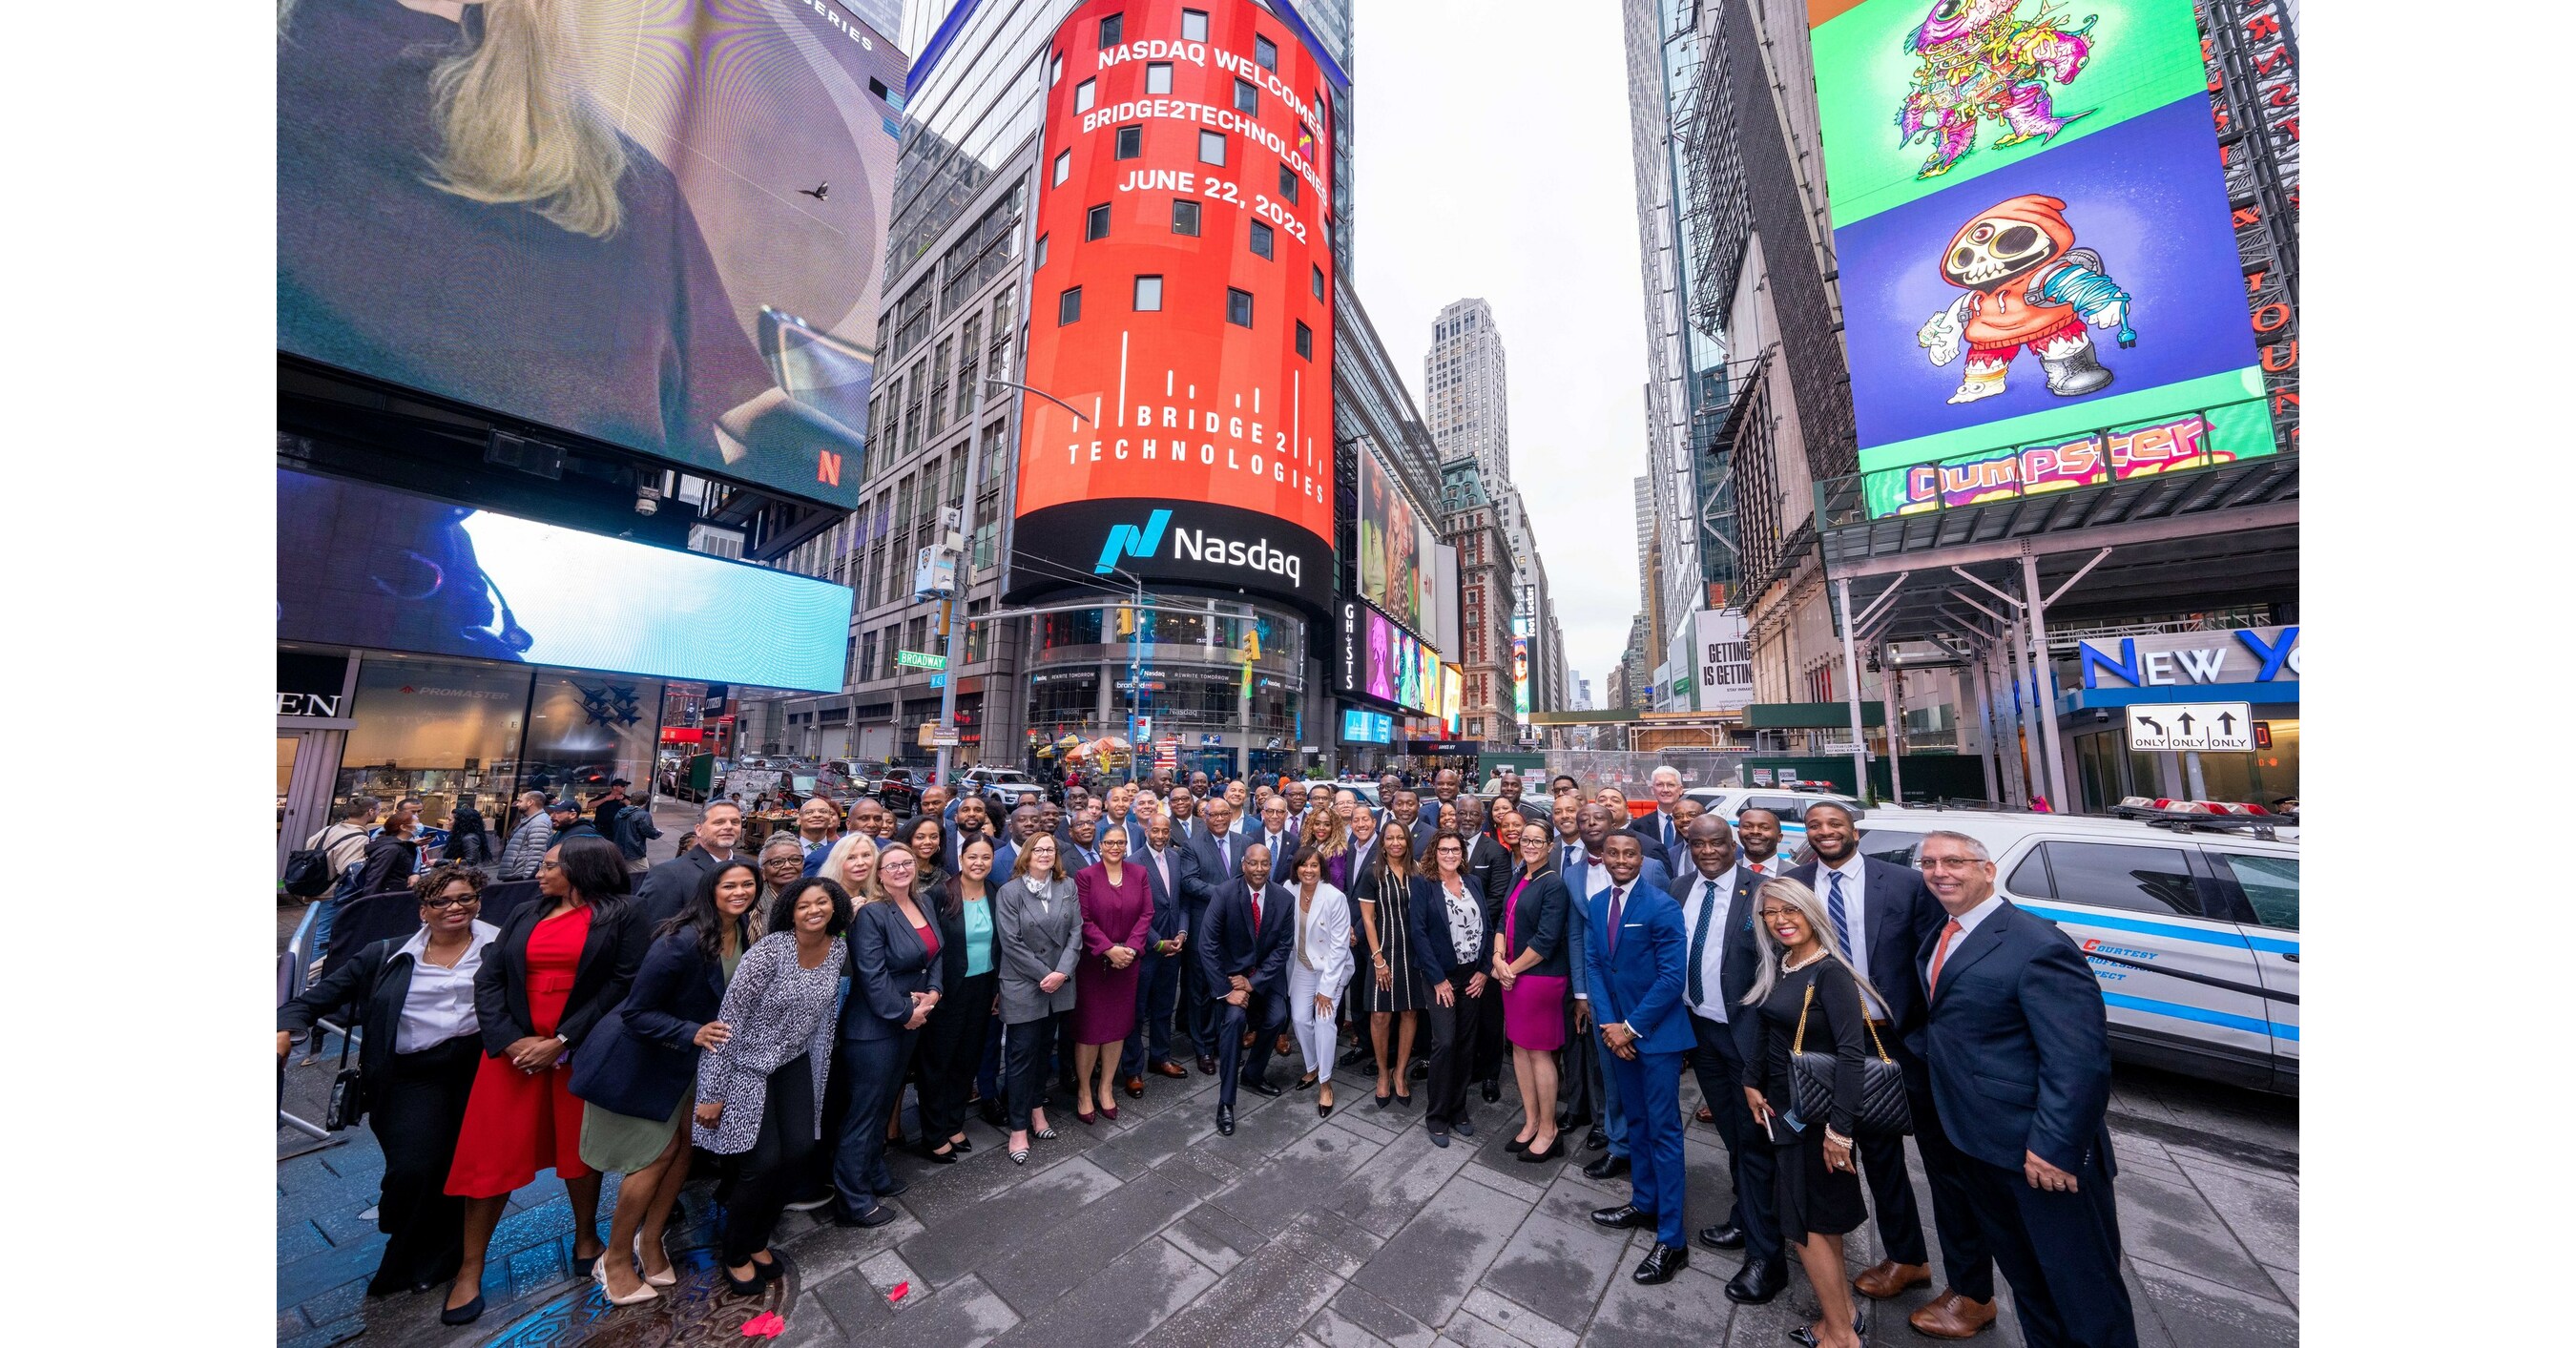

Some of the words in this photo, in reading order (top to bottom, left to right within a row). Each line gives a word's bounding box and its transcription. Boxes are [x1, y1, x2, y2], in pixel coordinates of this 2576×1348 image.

[1098, 40, 1206, 71] NASDAQ
[1215, 48, 1324, 145] WELCOMES
[1083, 99, 1328, 208] BRIDGE2TECHNOLOGIES
[1119, 170, 1195, 193] JUNE
[1204, 176, 1246, 209] 22,
[1256, 195, 1307, 244] 2022
[1137, 405, 1263, 445] BRIDGE
[1277, 432, 1287, 453] 2
[819, 450, 841, 487] N
[1069, 439, 1323, 504] TECHNOLOGIES
[1174, 528, 1299, 588] Nasdaq
[901, 653, 944, 668] BROADWAY
[937, 675, 943, 685] 43
[1144, 670, 1165, 678] Nasdaq
[1703, 666, 1714, 686] IS
[418, 687, 510, 700] PROMASTER
[1169, 708, 1197, 717] Nasdaq
[2135, 738, 2166, 747] ONLY
[2172, 738, 2205, 747] ONLY
[2212, 738, 2247, 748] ONLY
[2083, 939, 2158, 960] COURTESY
[2093, 970, 2127, 981] PECT
